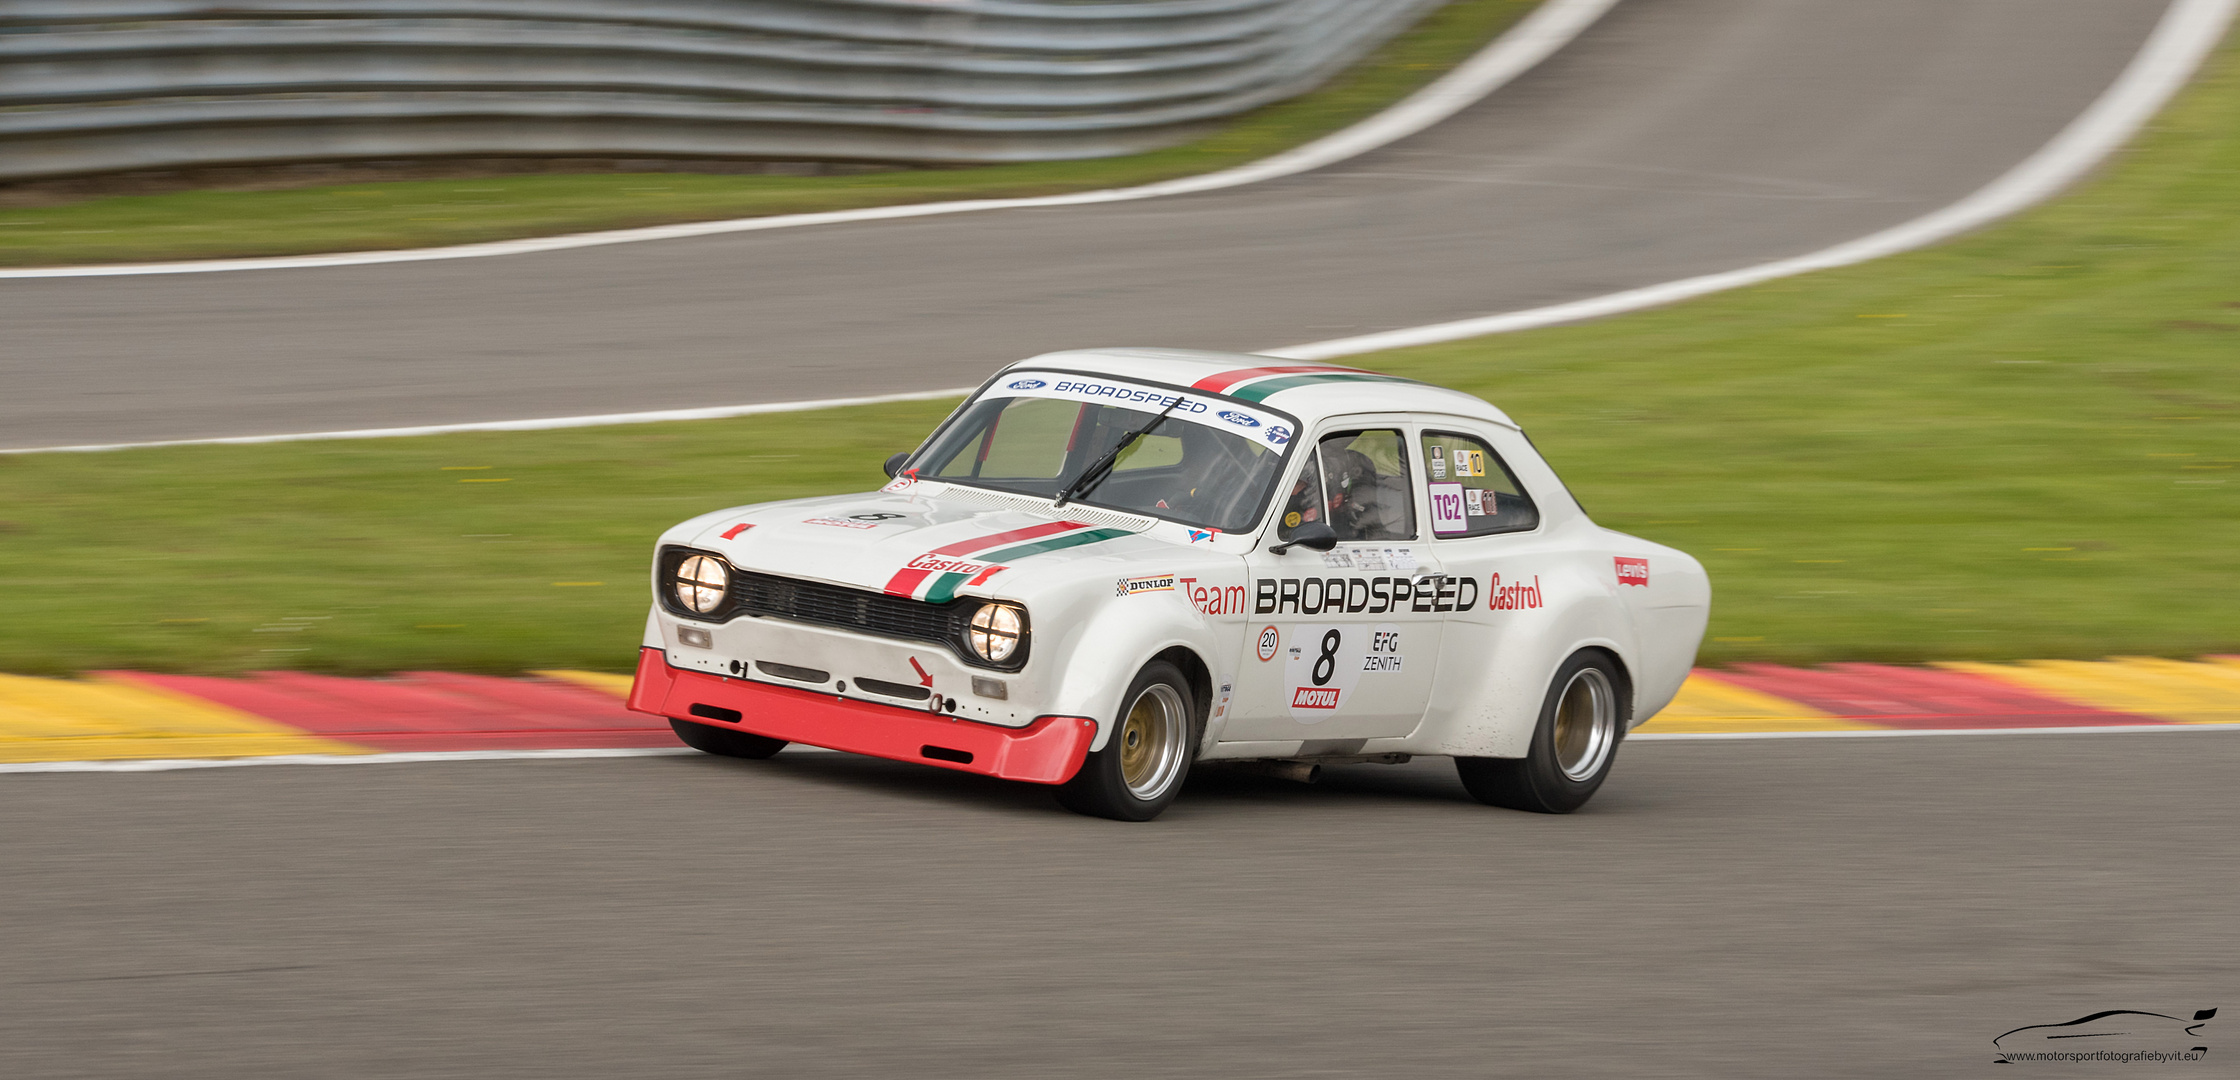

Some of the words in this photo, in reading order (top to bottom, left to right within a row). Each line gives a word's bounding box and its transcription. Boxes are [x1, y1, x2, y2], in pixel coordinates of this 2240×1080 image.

[1053, 381, 1208, 414] BROADSPEED
[1470, 453, 1482, 473] 10
[1433, 493, 1462, 521] TC2
[1130, 578, 1173, 590] DUNLOP
[1489, 572, 1543, 611] Castrol
[1180, 577, 1245, 615] Team
[1255, 576, 1479, 615] BROADSPEED
[1261, 632, 1276, 648] 20
[1373, 632, 1398, 653] EFG
[1312, 628, 1341, 687] 8
[1363, 656, 1402, 671] ZENITH
[1294, 690, 1337, 706] MOTUL
